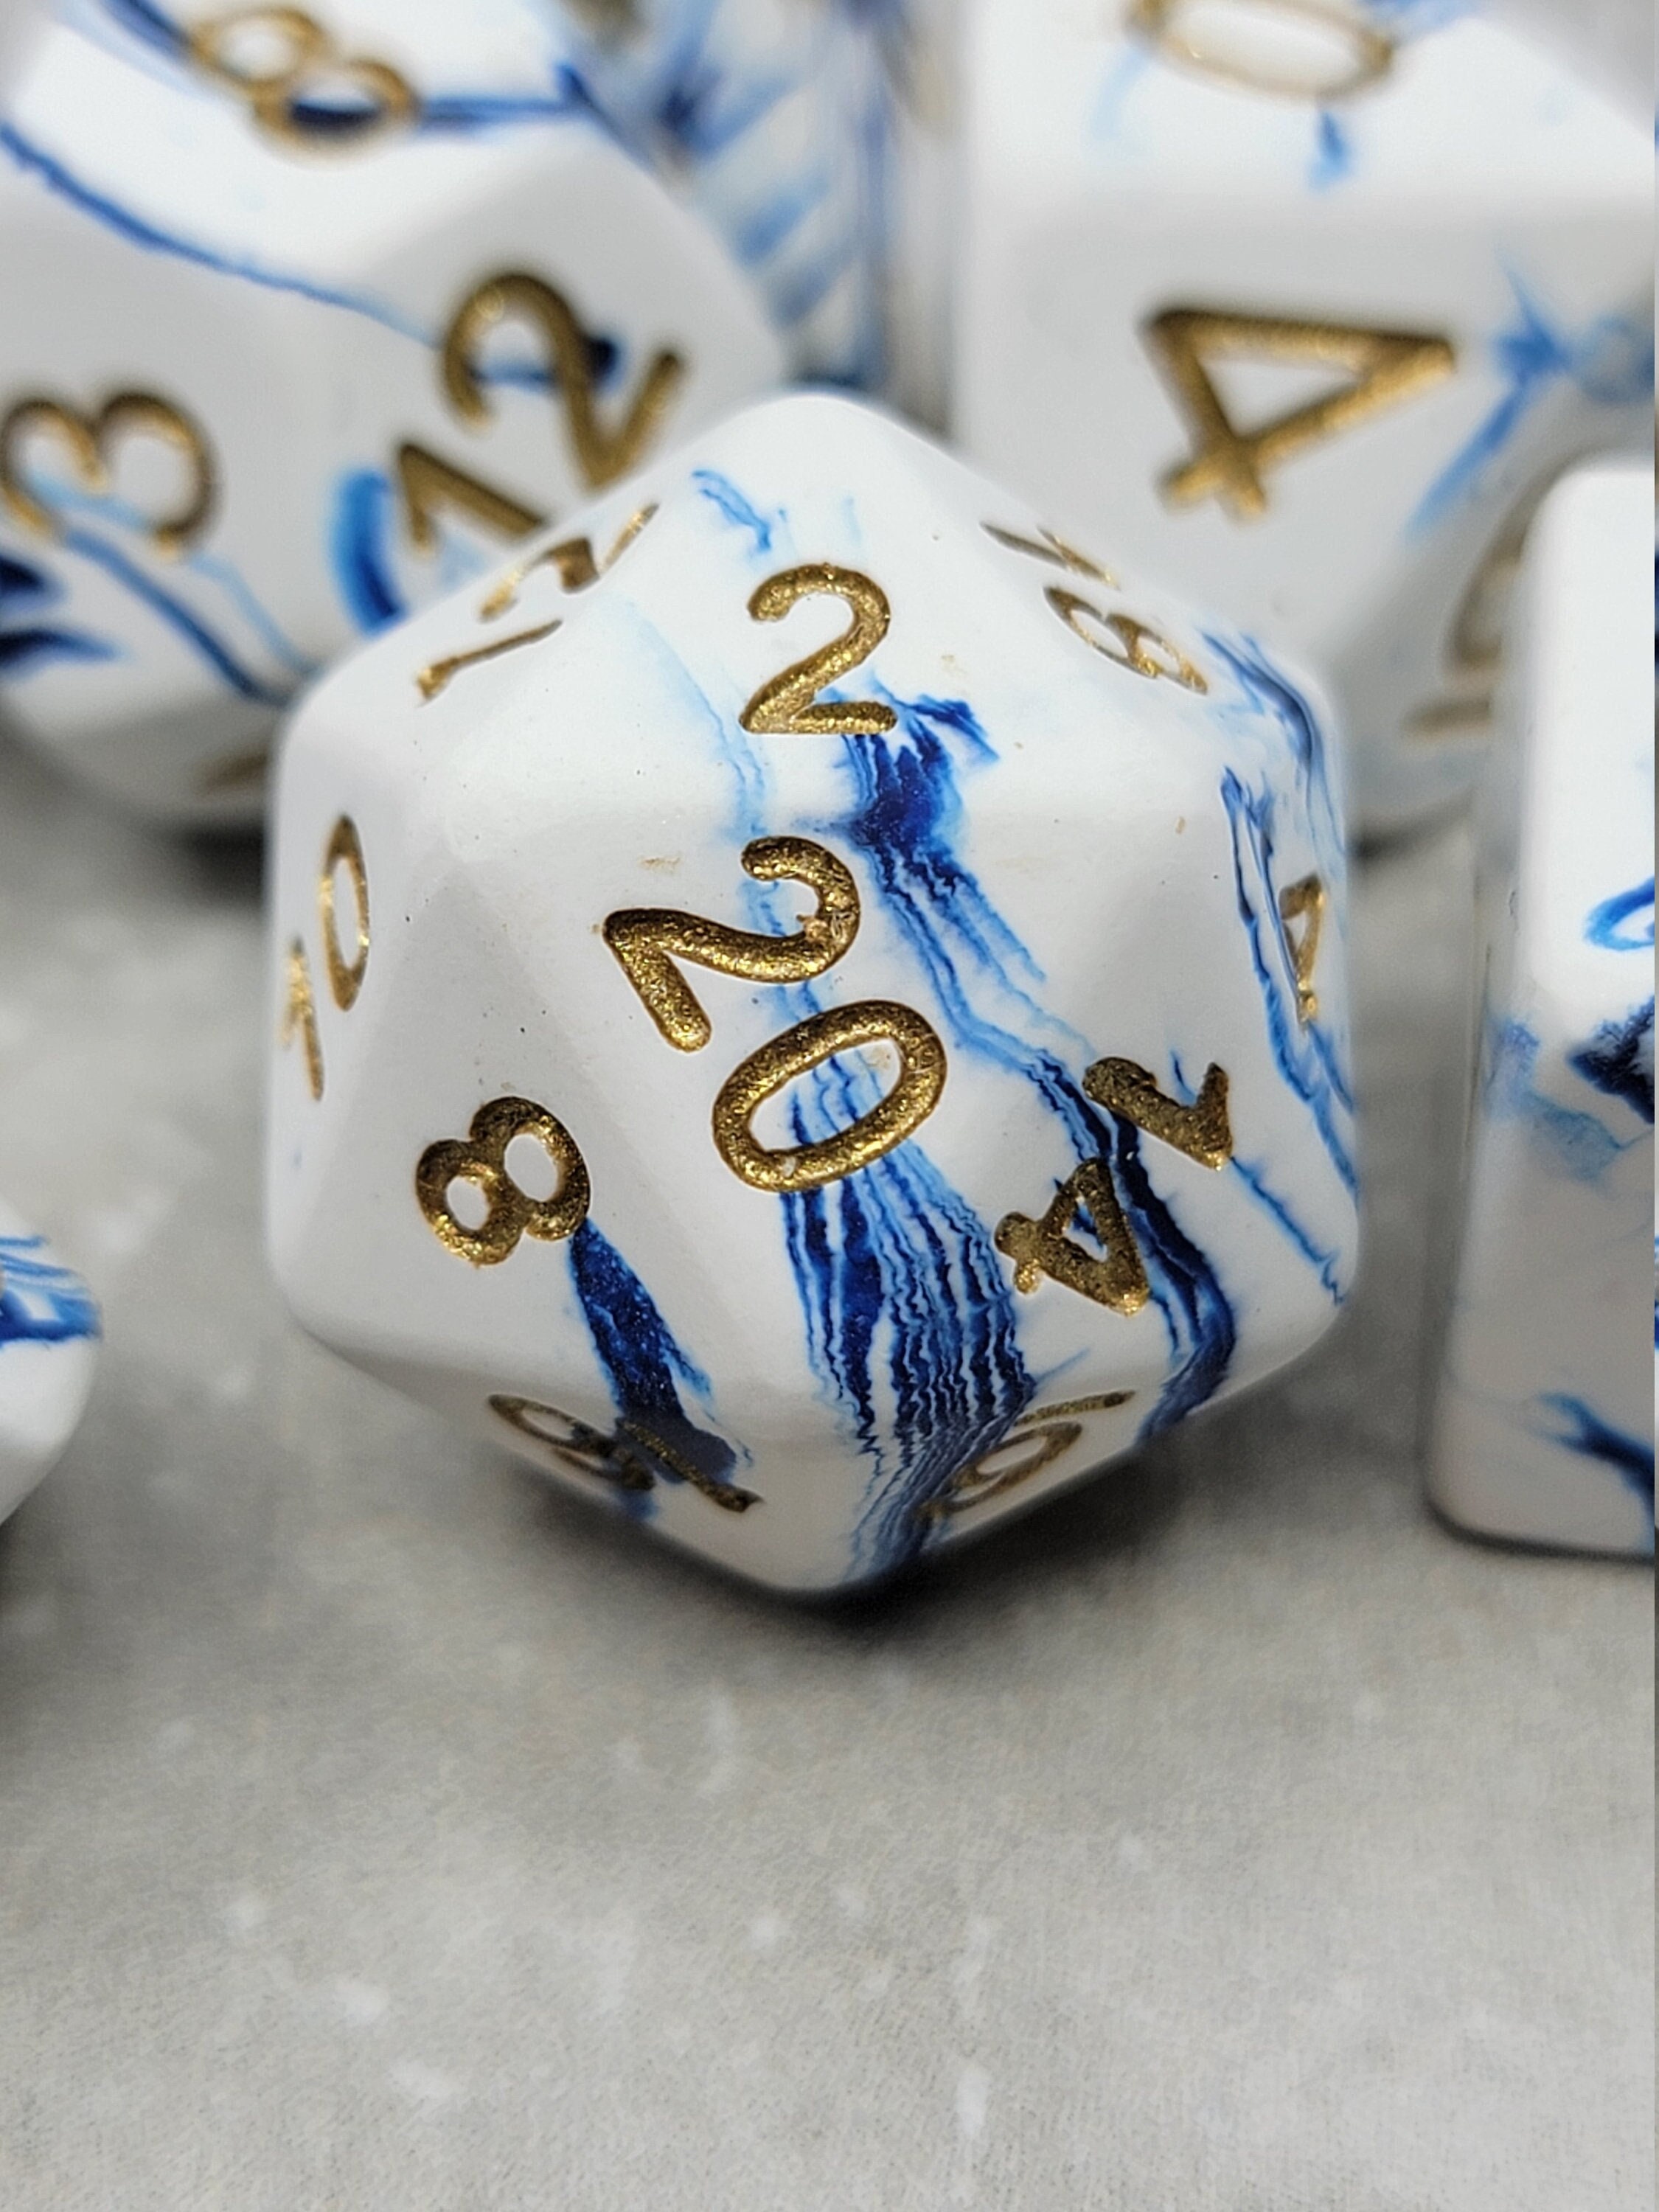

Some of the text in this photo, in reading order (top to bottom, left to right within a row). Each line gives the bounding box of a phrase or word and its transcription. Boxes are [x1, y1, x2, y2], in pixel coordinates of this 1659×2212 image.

[0, 392, 221, 560] 3
[398, 271, 686, 557] 12
[1144, 308, 1455, 519] 4
[415, 502, 660, 707] 12
[739, 563, 897, 734] 2
[602, 835, 948, 1193] 20
[415, 1096, 591, 1267] 8
[994, 1056, 1233, 1317] 14
